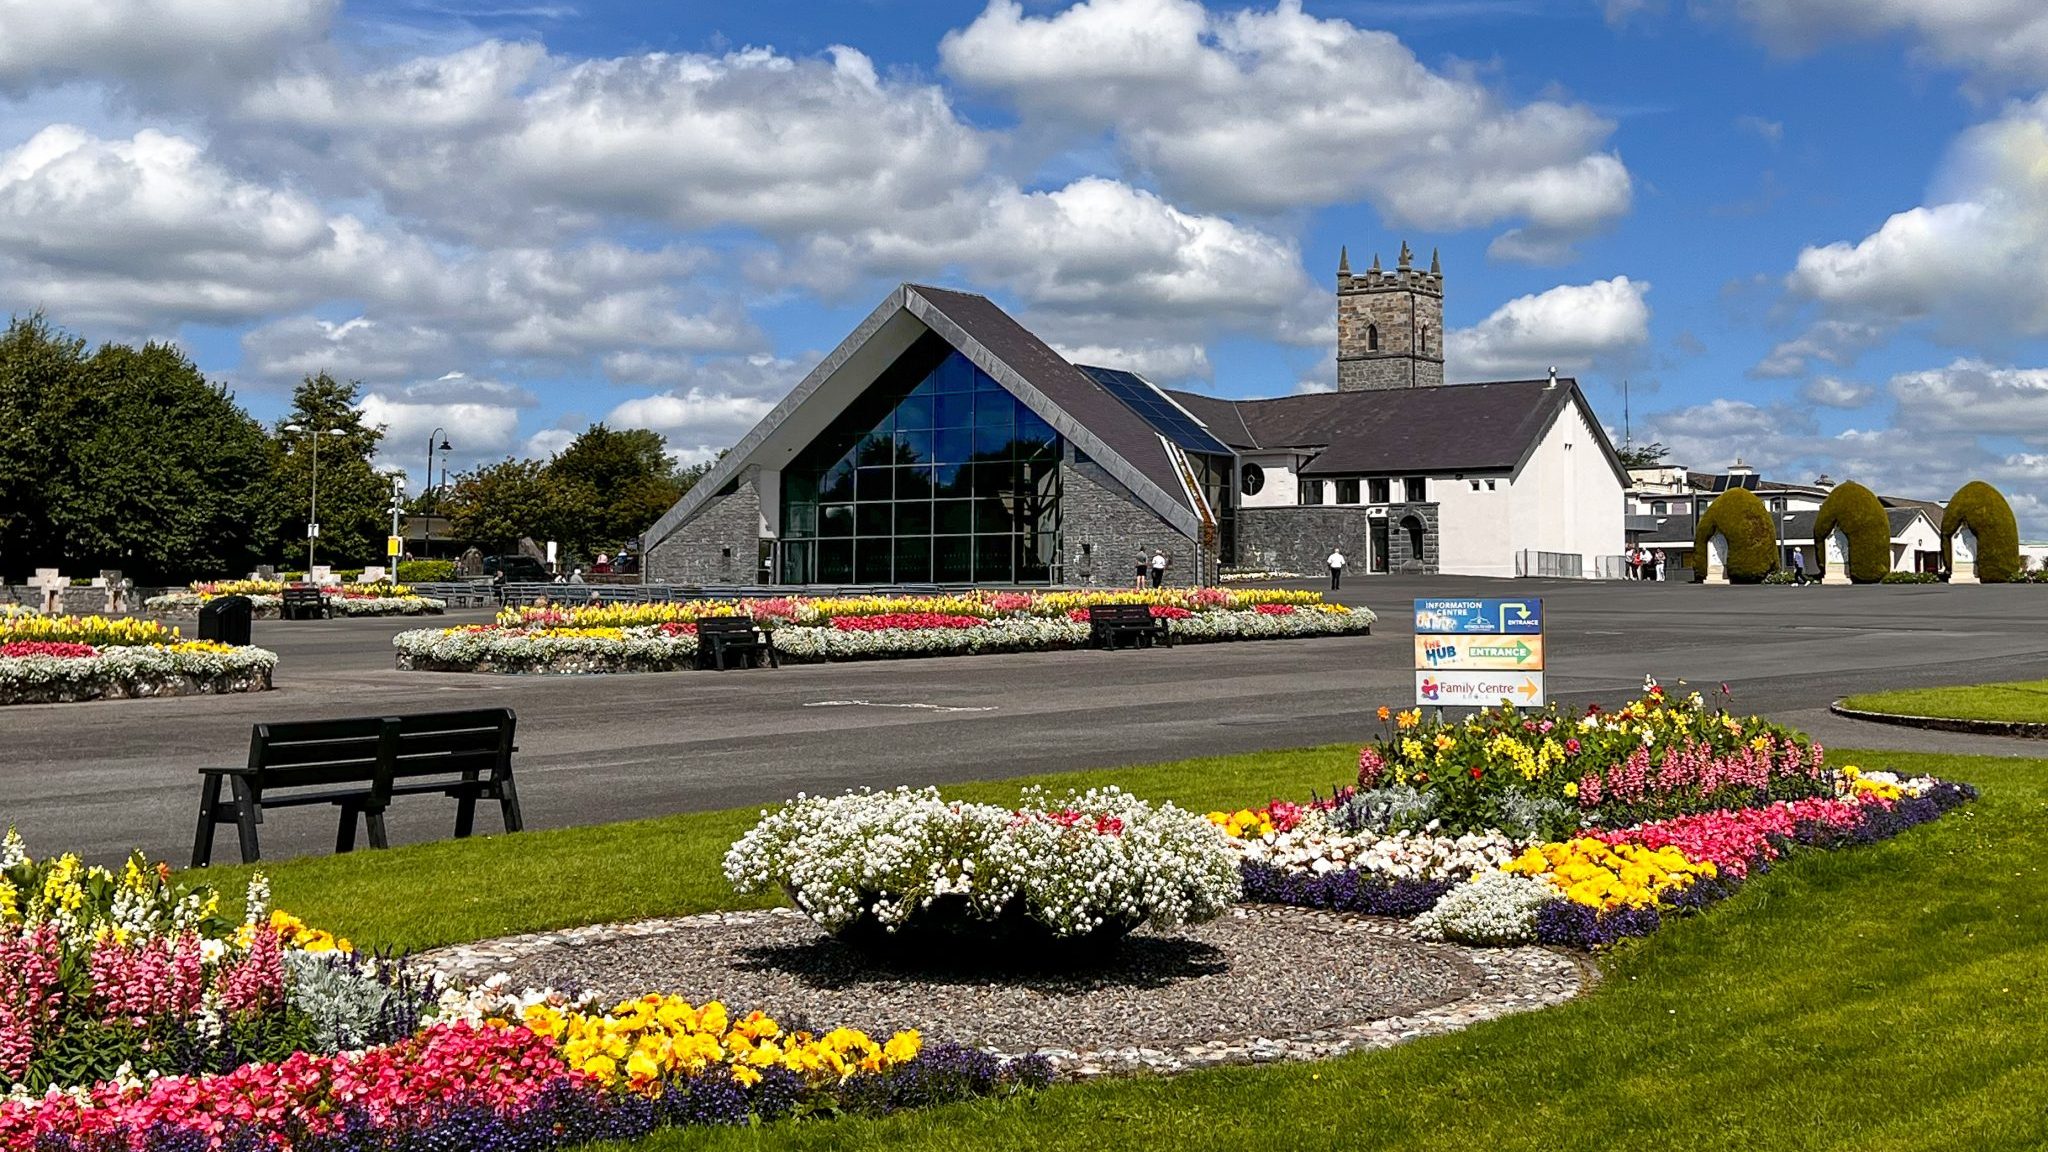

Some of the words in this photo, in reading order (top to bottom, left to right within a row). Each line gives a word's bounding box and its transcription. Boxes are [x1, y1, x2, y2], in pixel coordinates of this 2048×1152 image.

[1425, 601, 1482, 609] INFORMATION
[1425, 645, 1457, 666] HUB
[1470, 648, 1527, 657] ENTRANCE
[1440, 681, 1475, 695] Family
[1477, 681, 1514, 694] Centre
